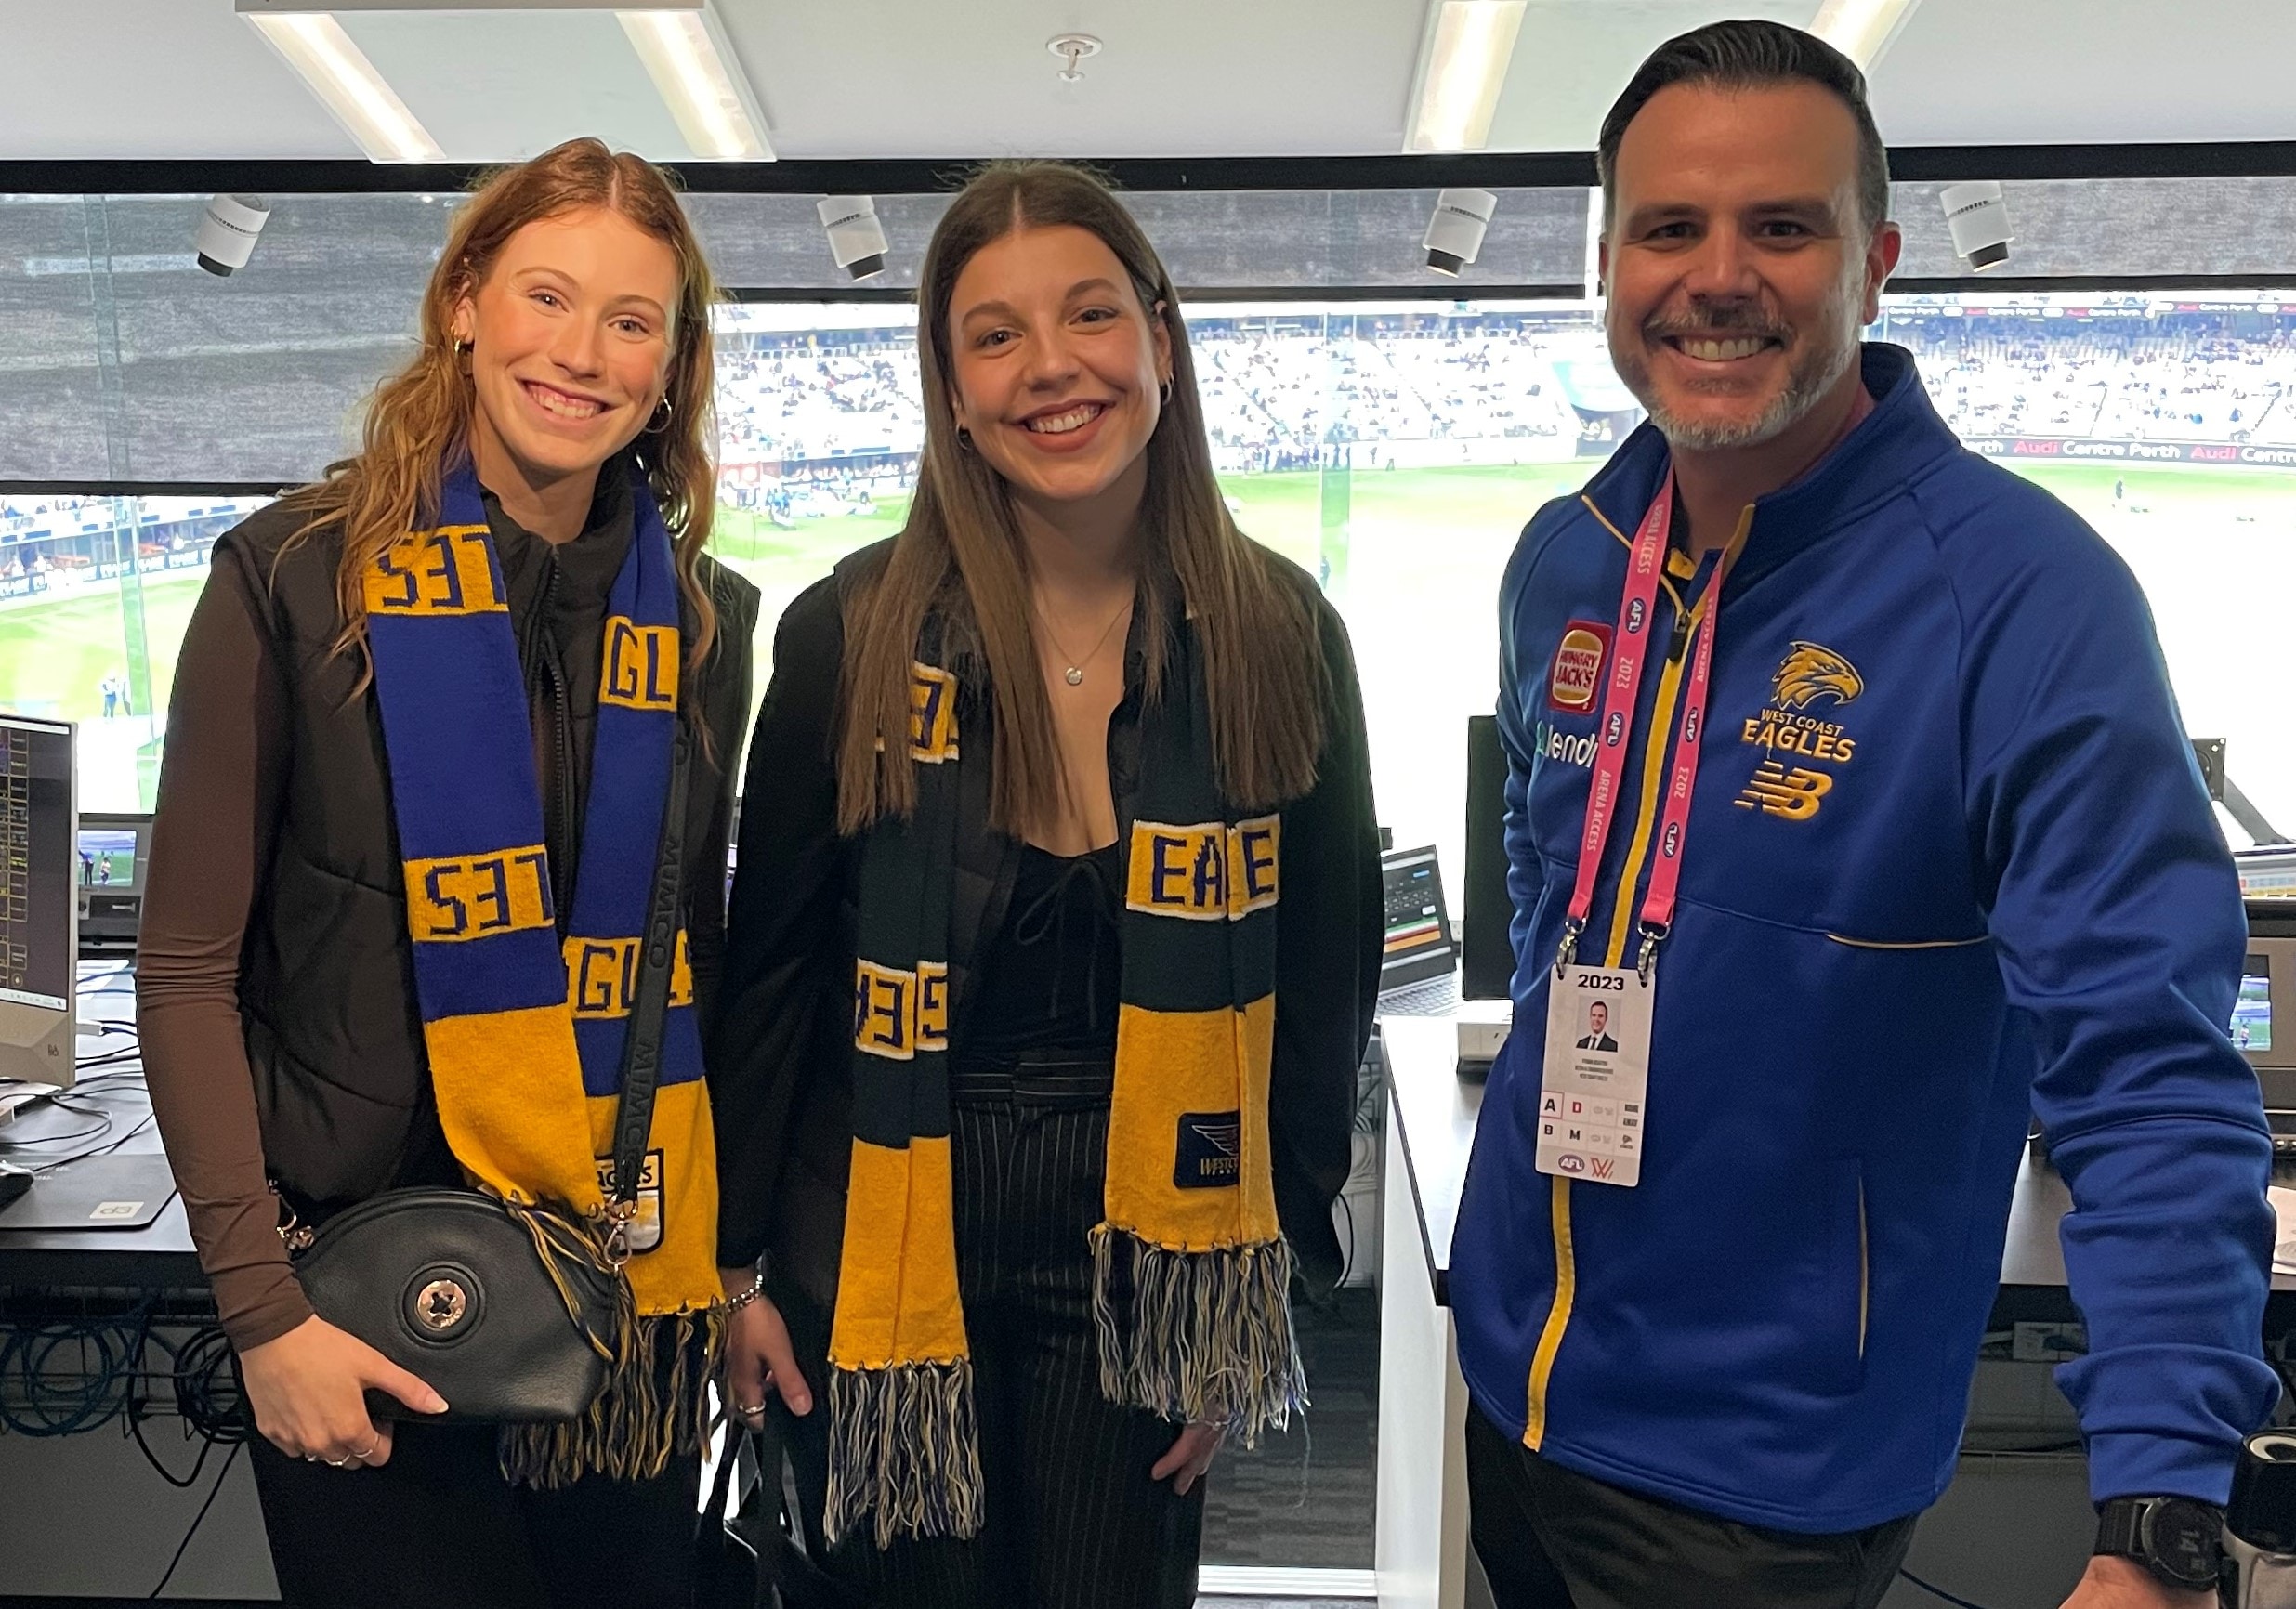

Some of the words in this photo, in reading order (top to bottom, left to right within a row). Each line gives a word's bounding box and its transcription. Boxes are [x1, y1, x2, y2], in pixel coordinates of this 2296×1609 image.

[2014, 440, 2059, 454] Audi
[2062, 440, 2125, 456] Centre
[2129, 442, 2181, 458] Perth
[2190, 446, 2237, 460] Audi
[1637, 535, 1657, 575] ACCESS
[1627, 600, 1644, 633] AFL
[1560, 650, 1598, 668] HUNGRY
[1616, 656, 1634, 689] 2023
[1555, 665, 1594, 688] JACK'S
[1607, 713, 1623, 745] AFL
[1686, 708, 1699, 741] AFL
[1761, 708, 1796, 725] WEST
[1795, 715, 1844, 737] COAST
[1740, 718, 1856, 762] EAGLES
[1594, 769, 1612, 808] ARENA
[1673, 766, 1690, 799] 2023
[1586, 808, 1604, 852] ACCESS
[1664, 823, 1679, 857] AFL
[649, 836, 681, 968] MIMCO
[1577, 974, 1624, 991] 2023
[1544, 1098, 1556, 1113] A
[1572, 1101, 1582, 1114] D
[1543, 1123, 1554, 1135] B
[1568, 1129, 1581, 1141] M
[1560, 1157, 1583, 1171] AFL
